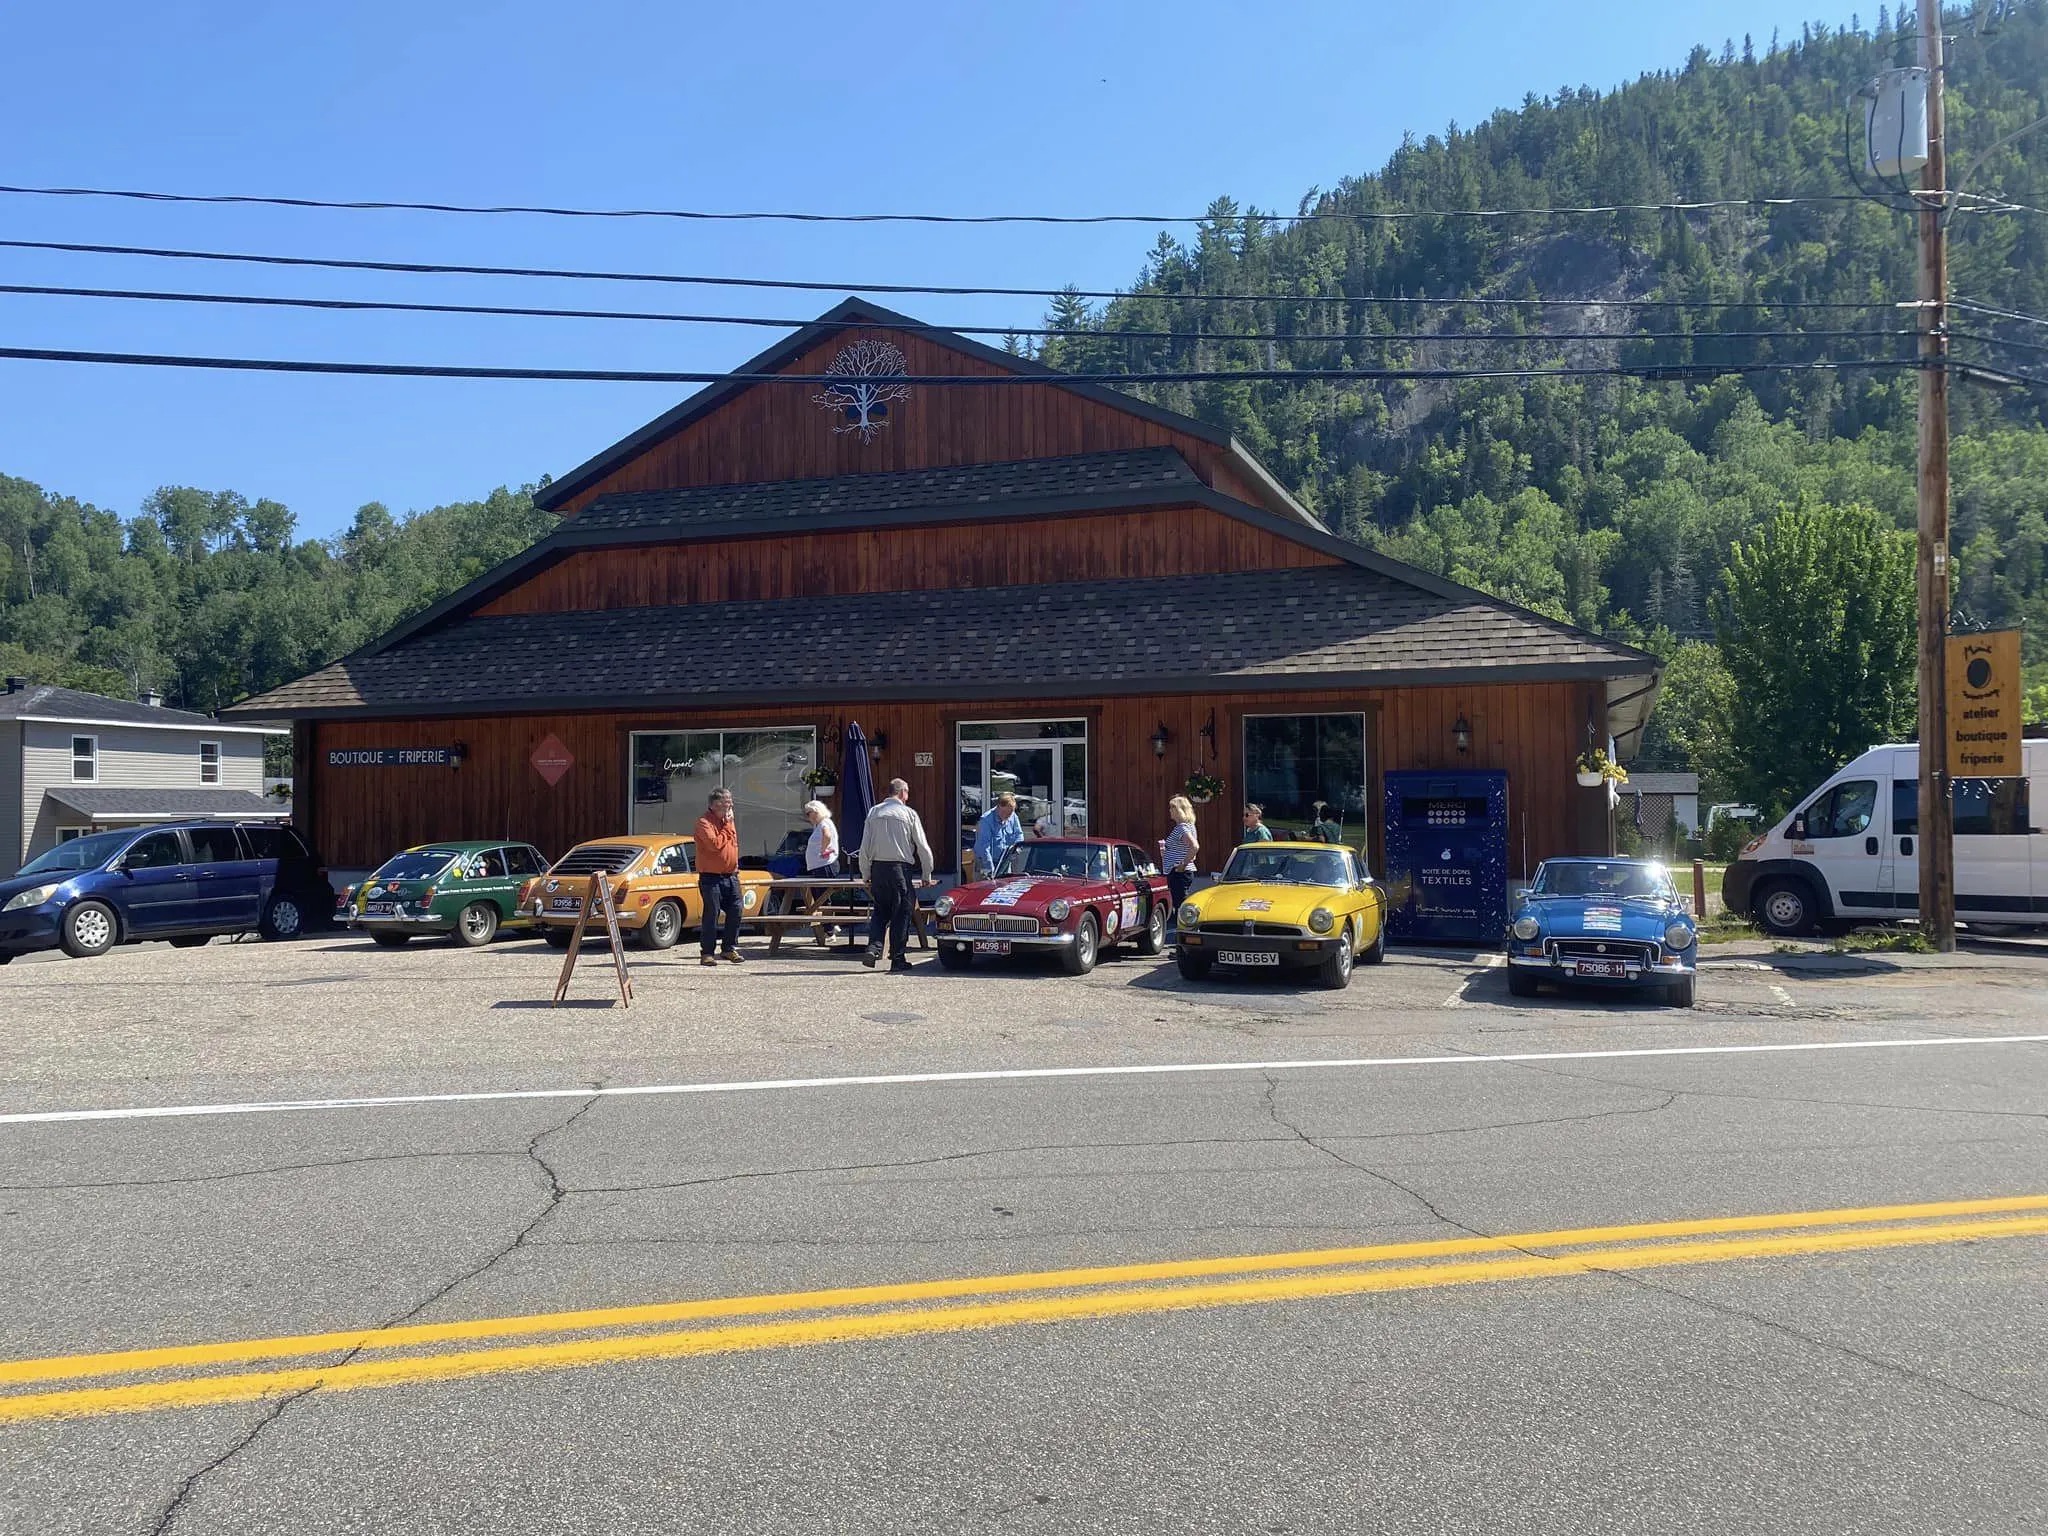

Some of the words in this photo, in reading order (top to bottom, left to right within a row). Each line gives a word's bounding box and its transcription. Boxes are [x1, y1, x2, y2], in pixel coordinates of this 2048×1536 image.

[1963, 706, 1999, 719] atelier
[1956, 730, 2008, 743] boutique
[329, 752, 384, 764] BOUTIQUE
[399, 750, 445, 763] FRIPERIE
[1961, 752, 2004, 766] friperie
[1428, 800, 1466, 809] MERCI
[1421, 876, 1472, 886] TEXTILES
[1219, 951, 1242, 963] BOM
[1245, 953, 1276, 964] 666V
